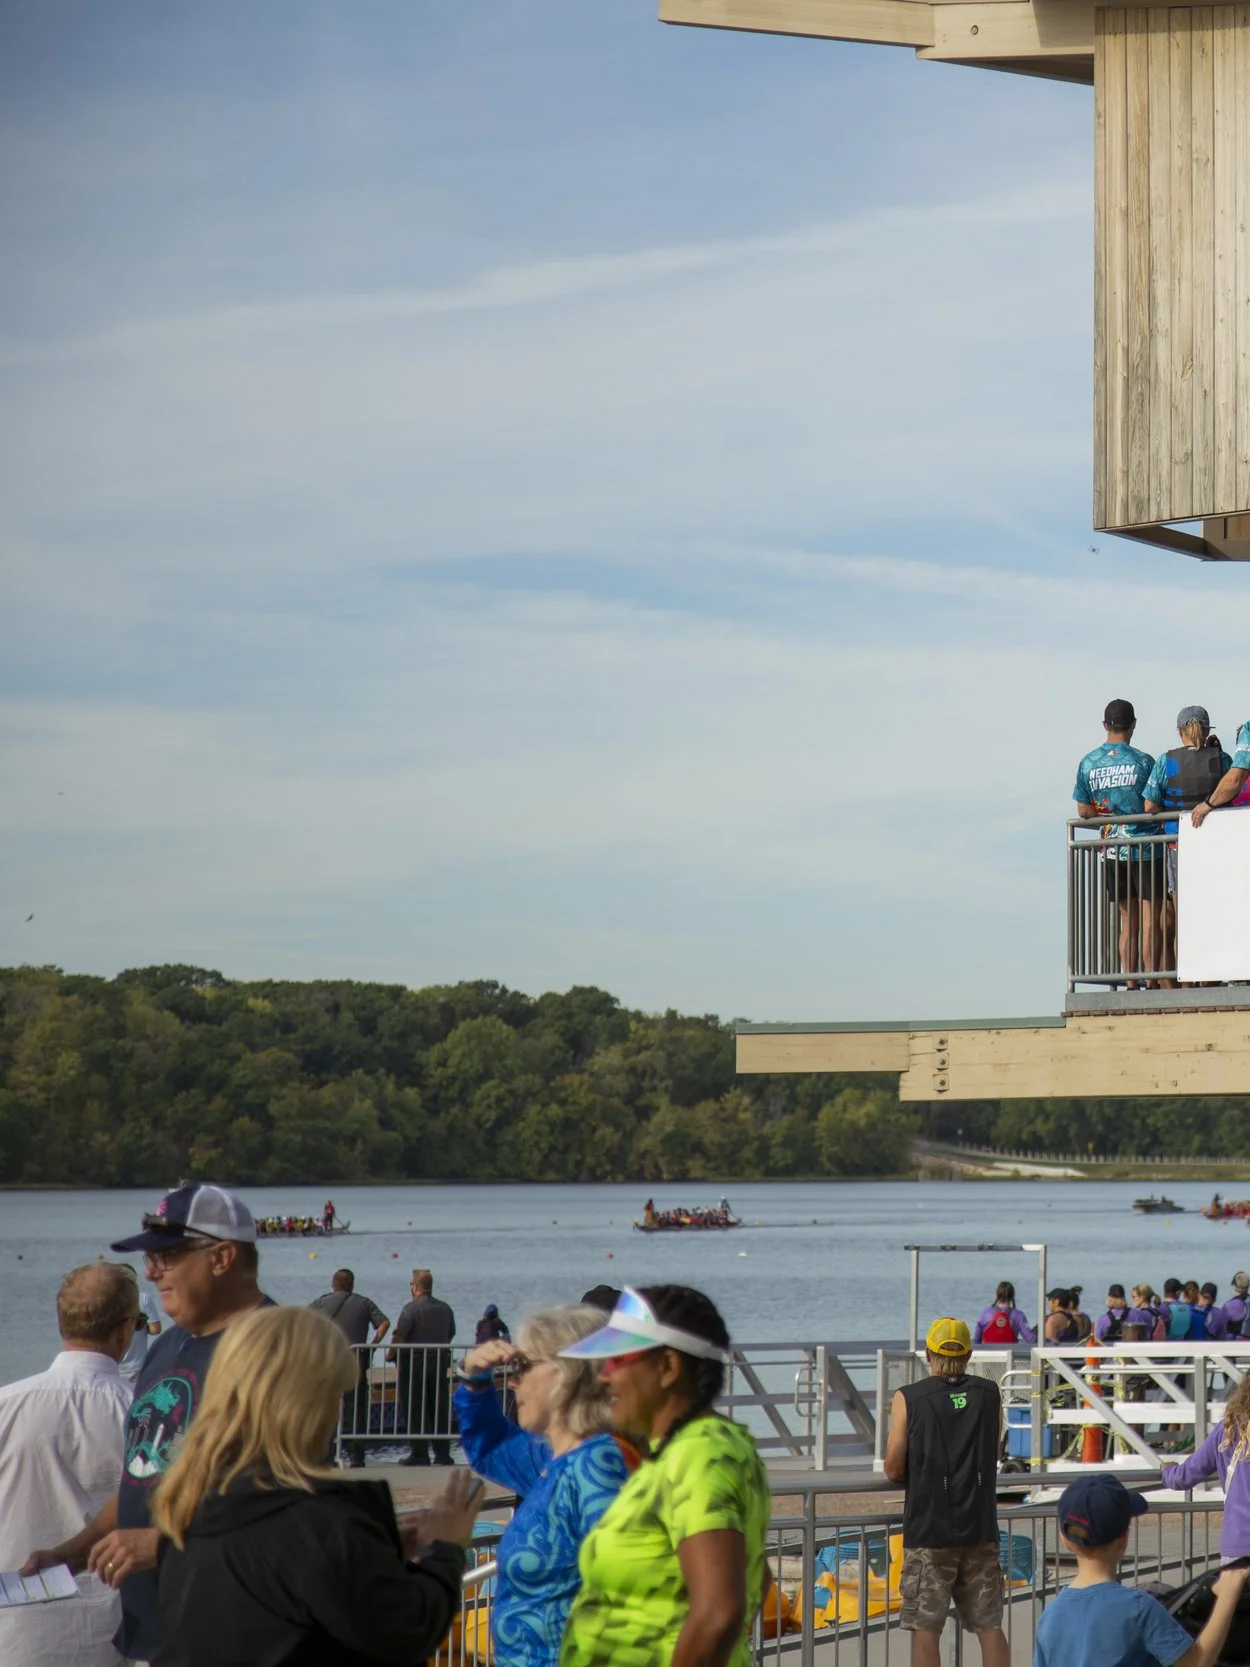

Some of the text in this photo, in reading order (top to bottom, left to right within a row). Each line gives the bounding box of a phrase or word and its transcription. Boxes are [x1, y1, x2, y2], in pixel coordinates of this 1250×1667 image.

[1089, 764, 1136, 780] NEEDHAM
[1089, 774, 1138, 792] INVASION
[952, 1397, 967, 1409] 19
